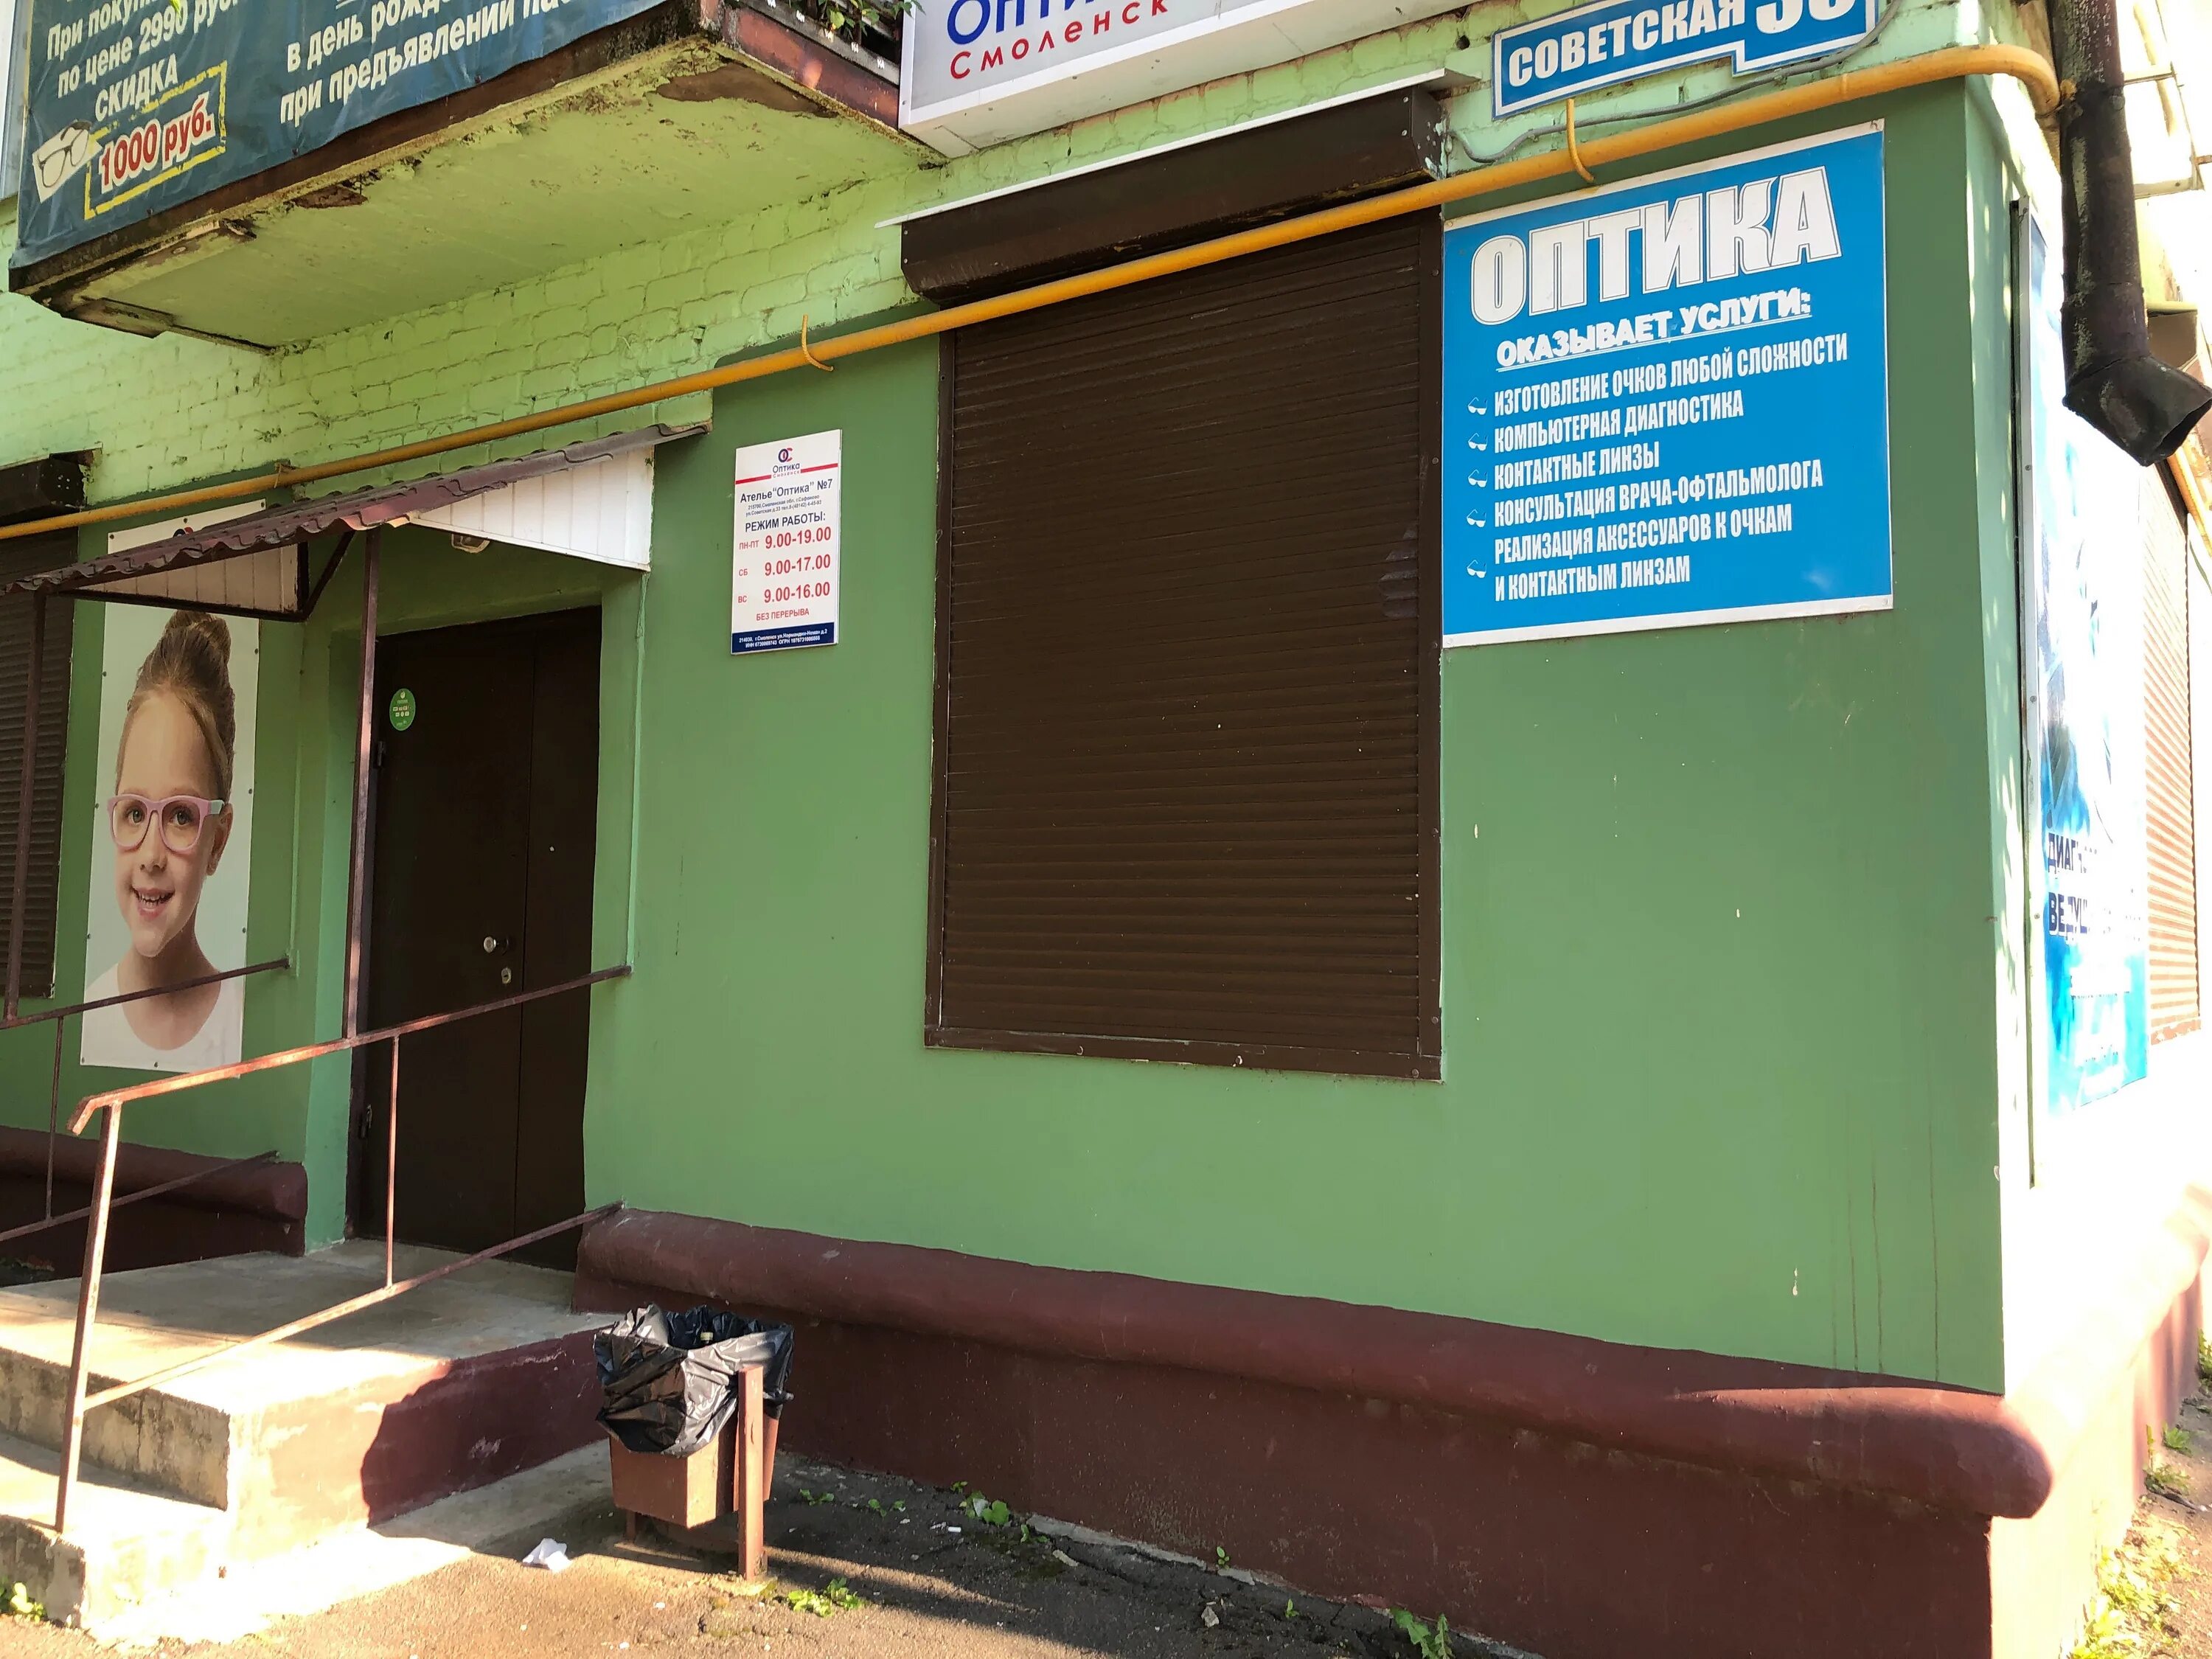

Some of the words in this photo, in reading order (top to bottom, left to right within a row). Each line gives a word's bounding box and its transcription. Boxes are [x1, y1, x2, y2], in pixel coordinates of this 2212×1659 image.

[47, 17, 83, 61] При
[88, 0, 155, 38] поку
[58, 64, 80, 99] по
[85, 35, 133, 86] цене
[139, 1, 188, 55] 2990
[287, 41, 301, 72] в
[307, 14, 364, 71] день
[371, 0, 450, 44] рож
[950, 0, 1168, 80] Смоленск
[1509, 0, 1745, 88] СОВЕТСКАЯ
[280, 78, 323, 128] при
[329, 0, 515, 105] предъявлении
[523, 0, 571, 18] па
[100, 121, 159, 190] 1000
[164, 94, 213, 165] руб.
[1470, 165, 1843, 326] ОПТИКА
[1496, 310, 1673, 367] ОКАЗЫВАЕТ
[1678, 287, 1812, 334] УСЛУГИ:
[1494, 378, 1609, 417] ИЗГОТОВЛЕНИЕ
[1612, 363, 1666, 397] ОЧКОВ
[1670, 347, 1733, 388] ЛЮБОЙ
[1736, 333, 1848, 377] СЛОЖНОСТИ
[1494, 408, 1621, 453] КОМПЬЮТЕРНАЯ
[1624, 389, 1744, 437] ДИАГНОСТИКА
[772, 462, 800, 473] Оптика
[817, 479, 832, 490] №7
[1494, 450, 1596, 490] КОНТАКТНЫЕ
[1599, 441, 1660, 476] ЛИНЗЫ
[1494, 487, 1615, 528] КОНСУЛЬТАЦИЯ
[1618, 459, 1823, 511] ВРАЧА-ОФТАЛЬМОЛОГА
[739, 540, 759, 550] ПН-ПТ
[765, 526, 832, 549] 9.00-19.00
[745, 518, 779, 532] РЕЖИМ
[782, 511, 826, 527] РАБОТЫ:
[1495, 527, 1593, 565] РЕАЛИЗАЦИЯ
[1596, 513, 1711, 553] АКСЕССУАРОВ
[1715, 512, 1726, 539] К
[1730, 503, 1792, 538] ОЧКАМ
[764, 581, 830, 603] 9.00-16.00
[765, 554, 831, 576] 9.00-17.00
[1495, 575, 1505, 602] И
[1508, 561, 1617, 601] КОНТАКТНЫМ
[1620, 554, 1691, 589] ЛИНЗАМ
[756, 613, 770, 621] БЕЗ
[771, 608, 810, 619] ПЕРЕРЫВА
